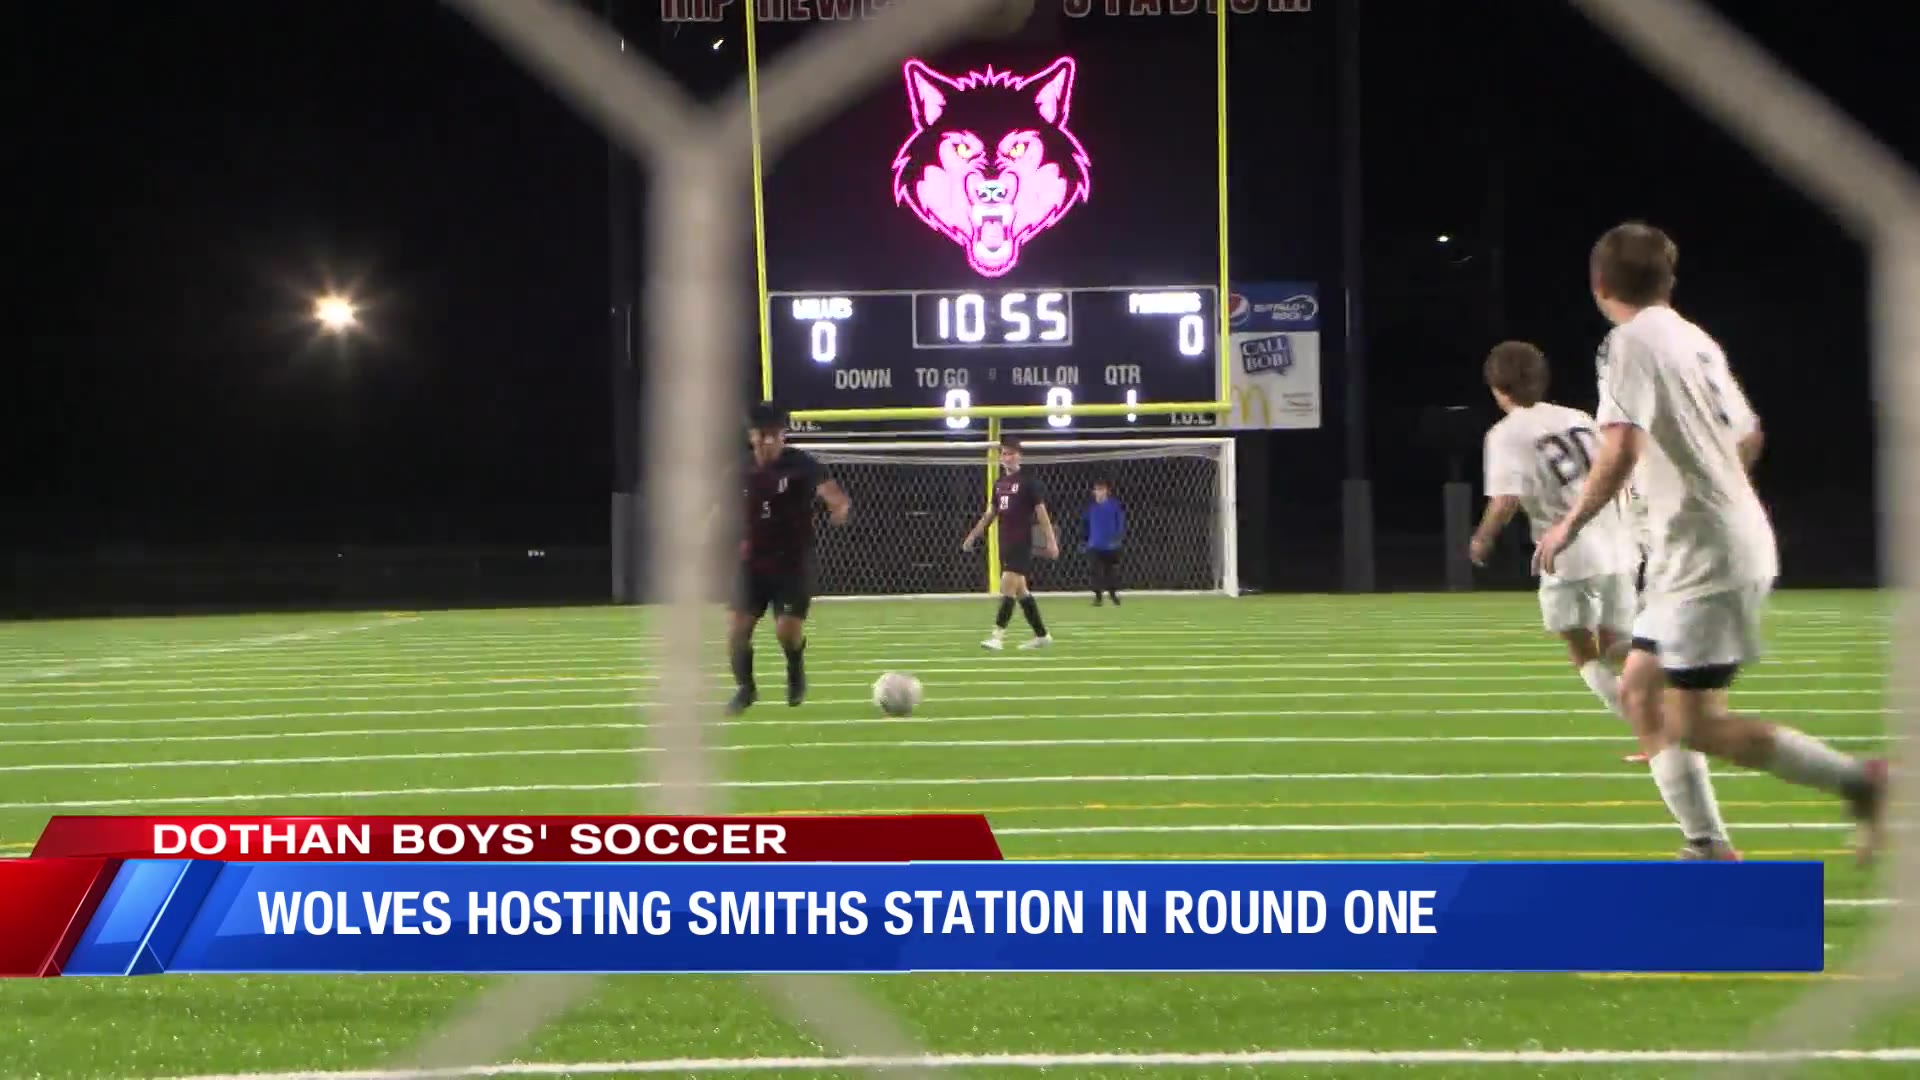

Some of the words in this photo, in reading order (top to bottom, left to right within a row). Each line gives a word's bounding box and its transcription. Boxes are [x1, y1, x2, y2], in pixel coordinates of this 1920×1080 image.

[811, 320, 837, 363] 0
[1179, 314, 1204, 356] 0
[835, 368, 892, 389] DOWN
[915, 367, 939, 387] TO
[944, 367, 969, 387] GO
[1012, 367, 1051, 386] BALL
[1056, 365, 1079, 385] ON
[1105, 364, 1142, 385] QTR
